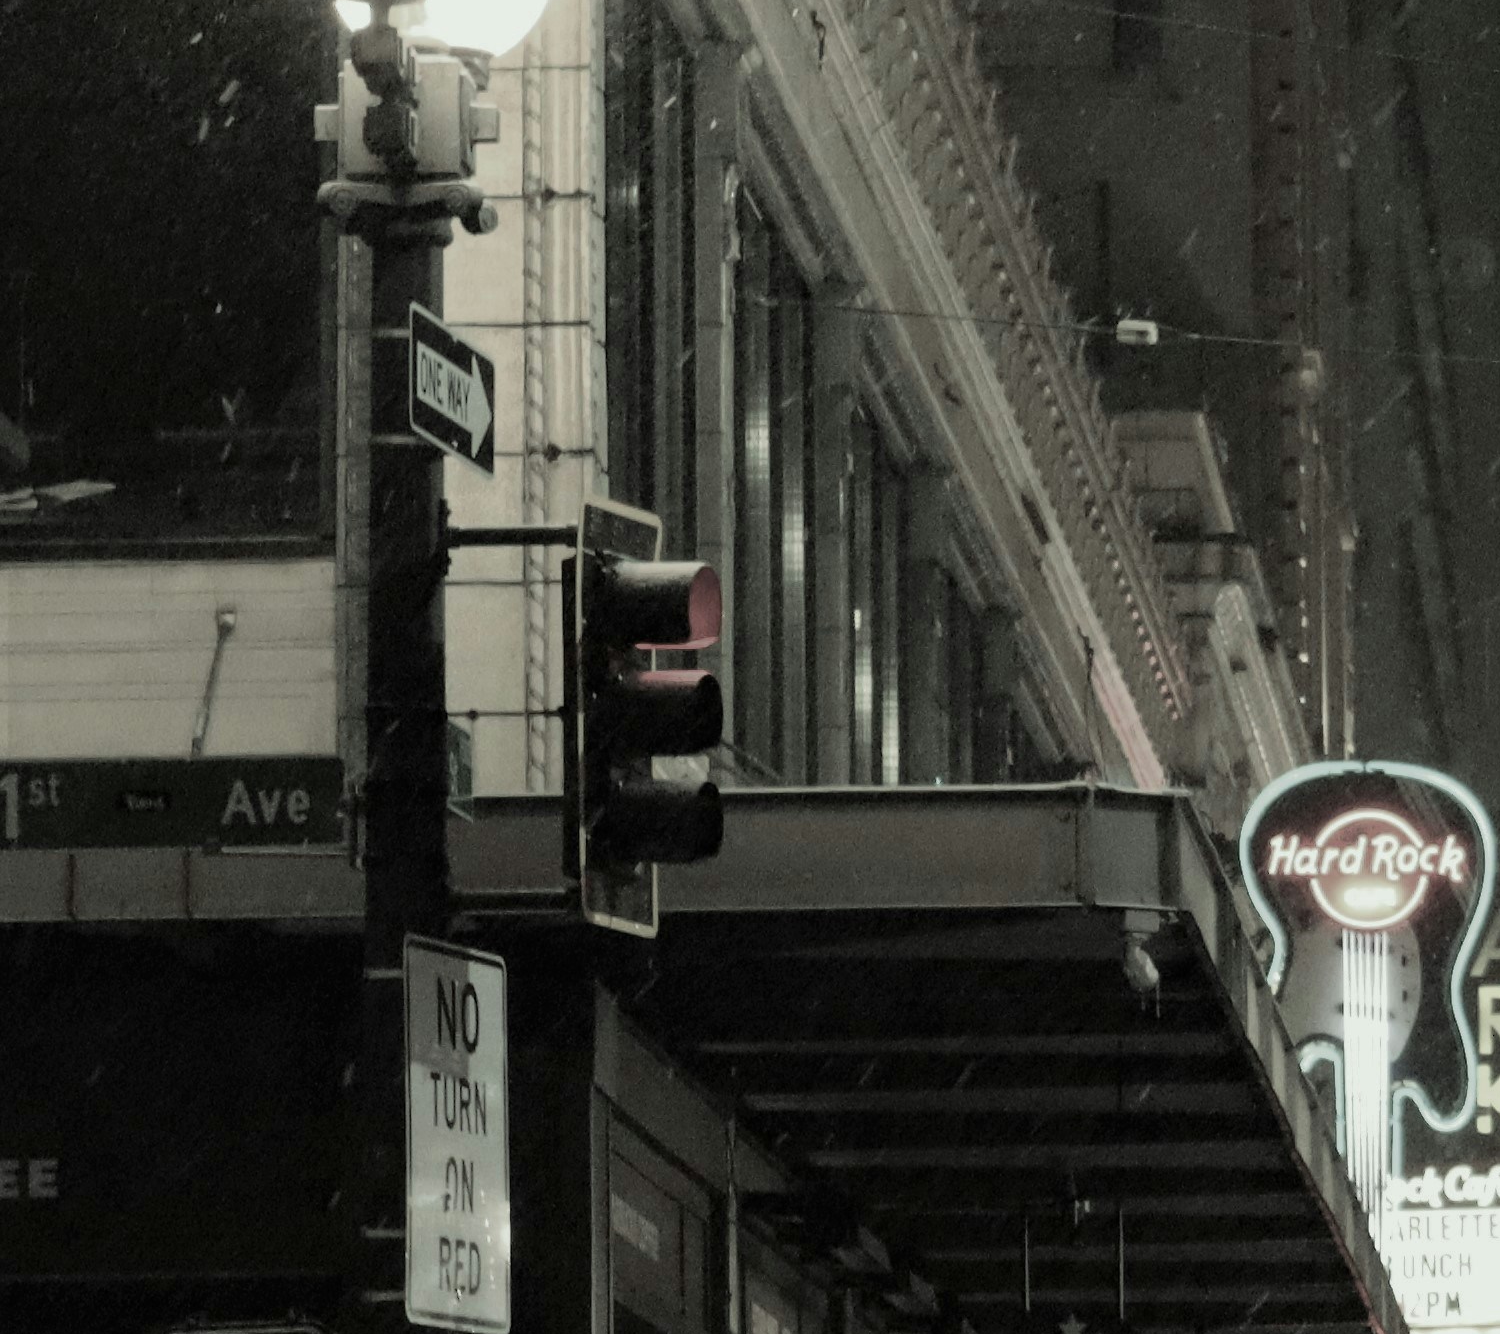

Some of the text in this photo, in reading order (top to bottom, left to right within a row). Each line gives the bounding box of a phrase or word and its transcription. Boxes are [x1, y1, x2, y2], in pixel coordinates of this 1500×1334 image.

[420, 351, 470, 424] ONE WAY
[0, 771, 311, 841] 1st Ave
[1267, 832, 1467, 883] Hard Rock
[436, 975, 480, 1054] NO
[429, 1071, 488, 1137] TURN
[445, 1155, 475, 1214] ON
[1385, 1166, 1443, 1208] ock
[438, 1235, 482, 1296] RED
